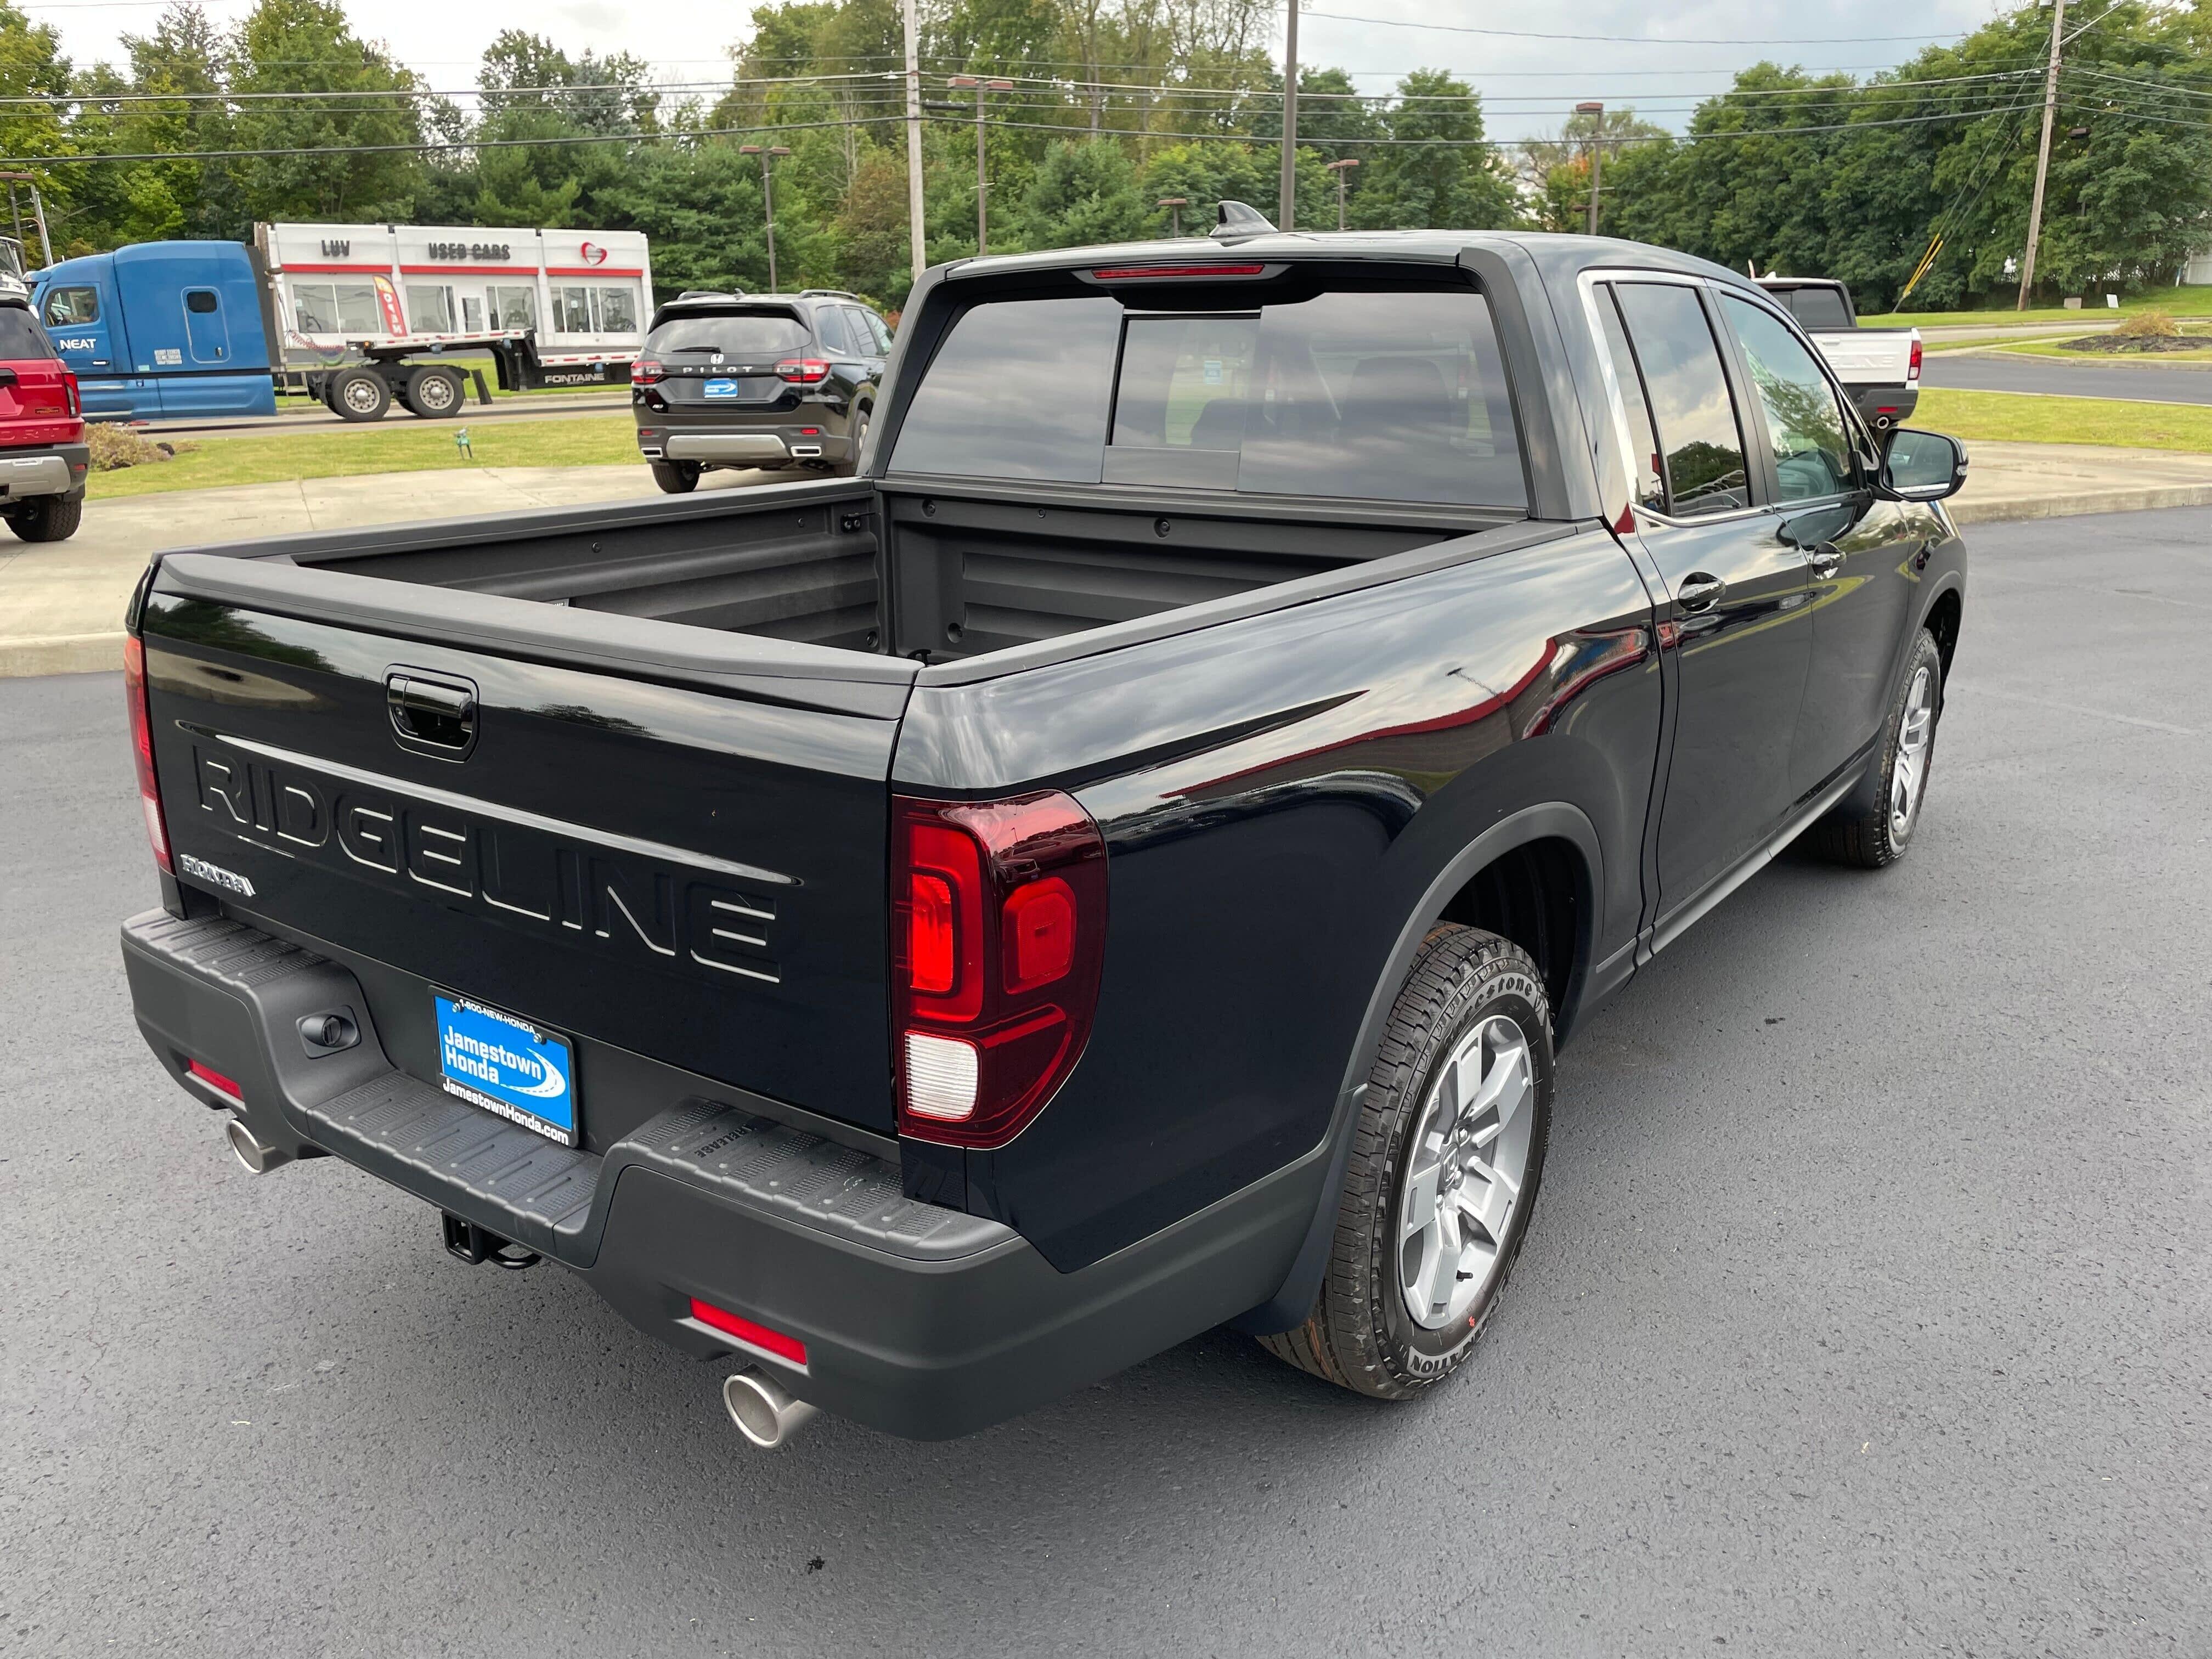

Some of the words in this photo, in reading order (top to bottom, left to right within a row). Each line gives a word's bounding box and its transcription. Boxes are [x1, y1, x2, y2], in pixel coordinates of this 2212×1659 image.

[321, 240, 350, 257] LUV
[428, 242, 467, 259] USED
[472, 244, 510, 260] CARS
[60, 338, 96, 349] NEAT
[545, 373, 605, 383] FONTAINE
[180, 854, 256, 897] HONDA
[193, 745, 780, 983] RIDGELINE
[459, 998, 537, 1035] 1-800-NEW-HONDA
[1444, 977, 1533, 1049] Firestone
[444, 1025, 541, 1081] Jamestown
[445, 1043, 499, 1085] Honda
[443, 1077, 569, 1146] JamestownHonda.com
